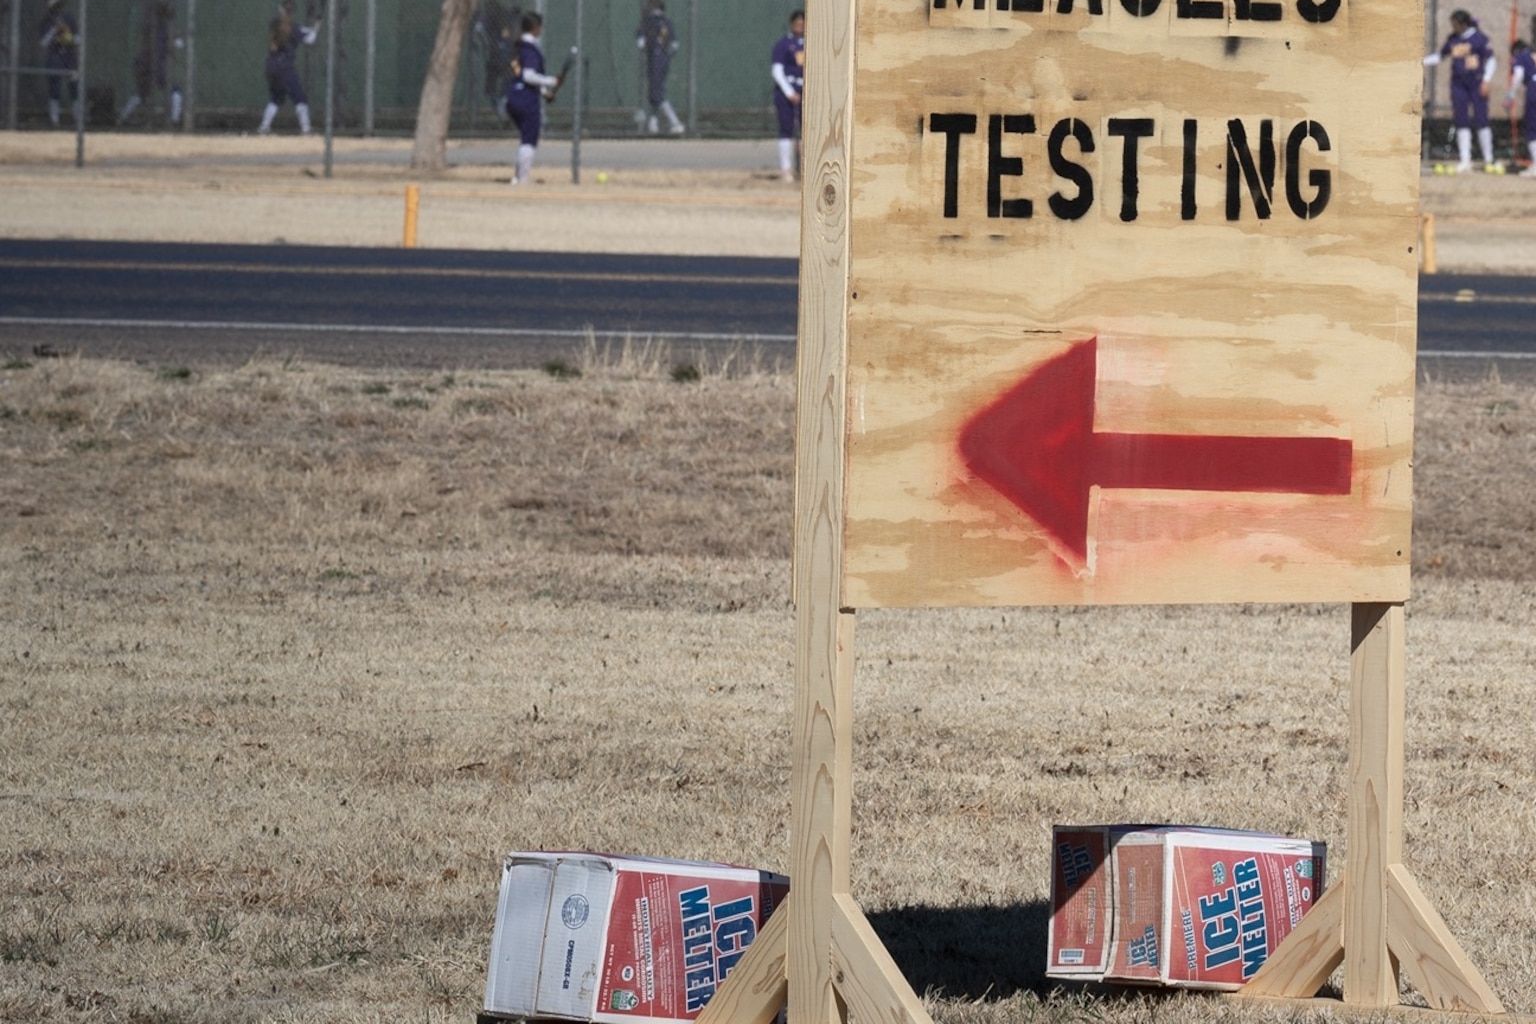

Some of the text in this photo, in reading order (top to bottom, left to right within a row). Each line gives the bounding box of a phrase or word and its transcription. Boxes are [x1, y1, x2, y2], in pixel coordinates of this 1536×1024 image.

[930, 112, 1332, 223] TESTING
[1072, 843, 1093, 874] ICE
[641, 899, 654, 999] INDUSTRIAL DUTY
[678, 884, 717, 1013] MELTER
[1130, 935, 1147, 966] ICE
[1181, 910, 1197, 970] PREMIERE
[1198, 887, 1241, 971] ICE
[1233, 857, 1268, 979] MELTER
